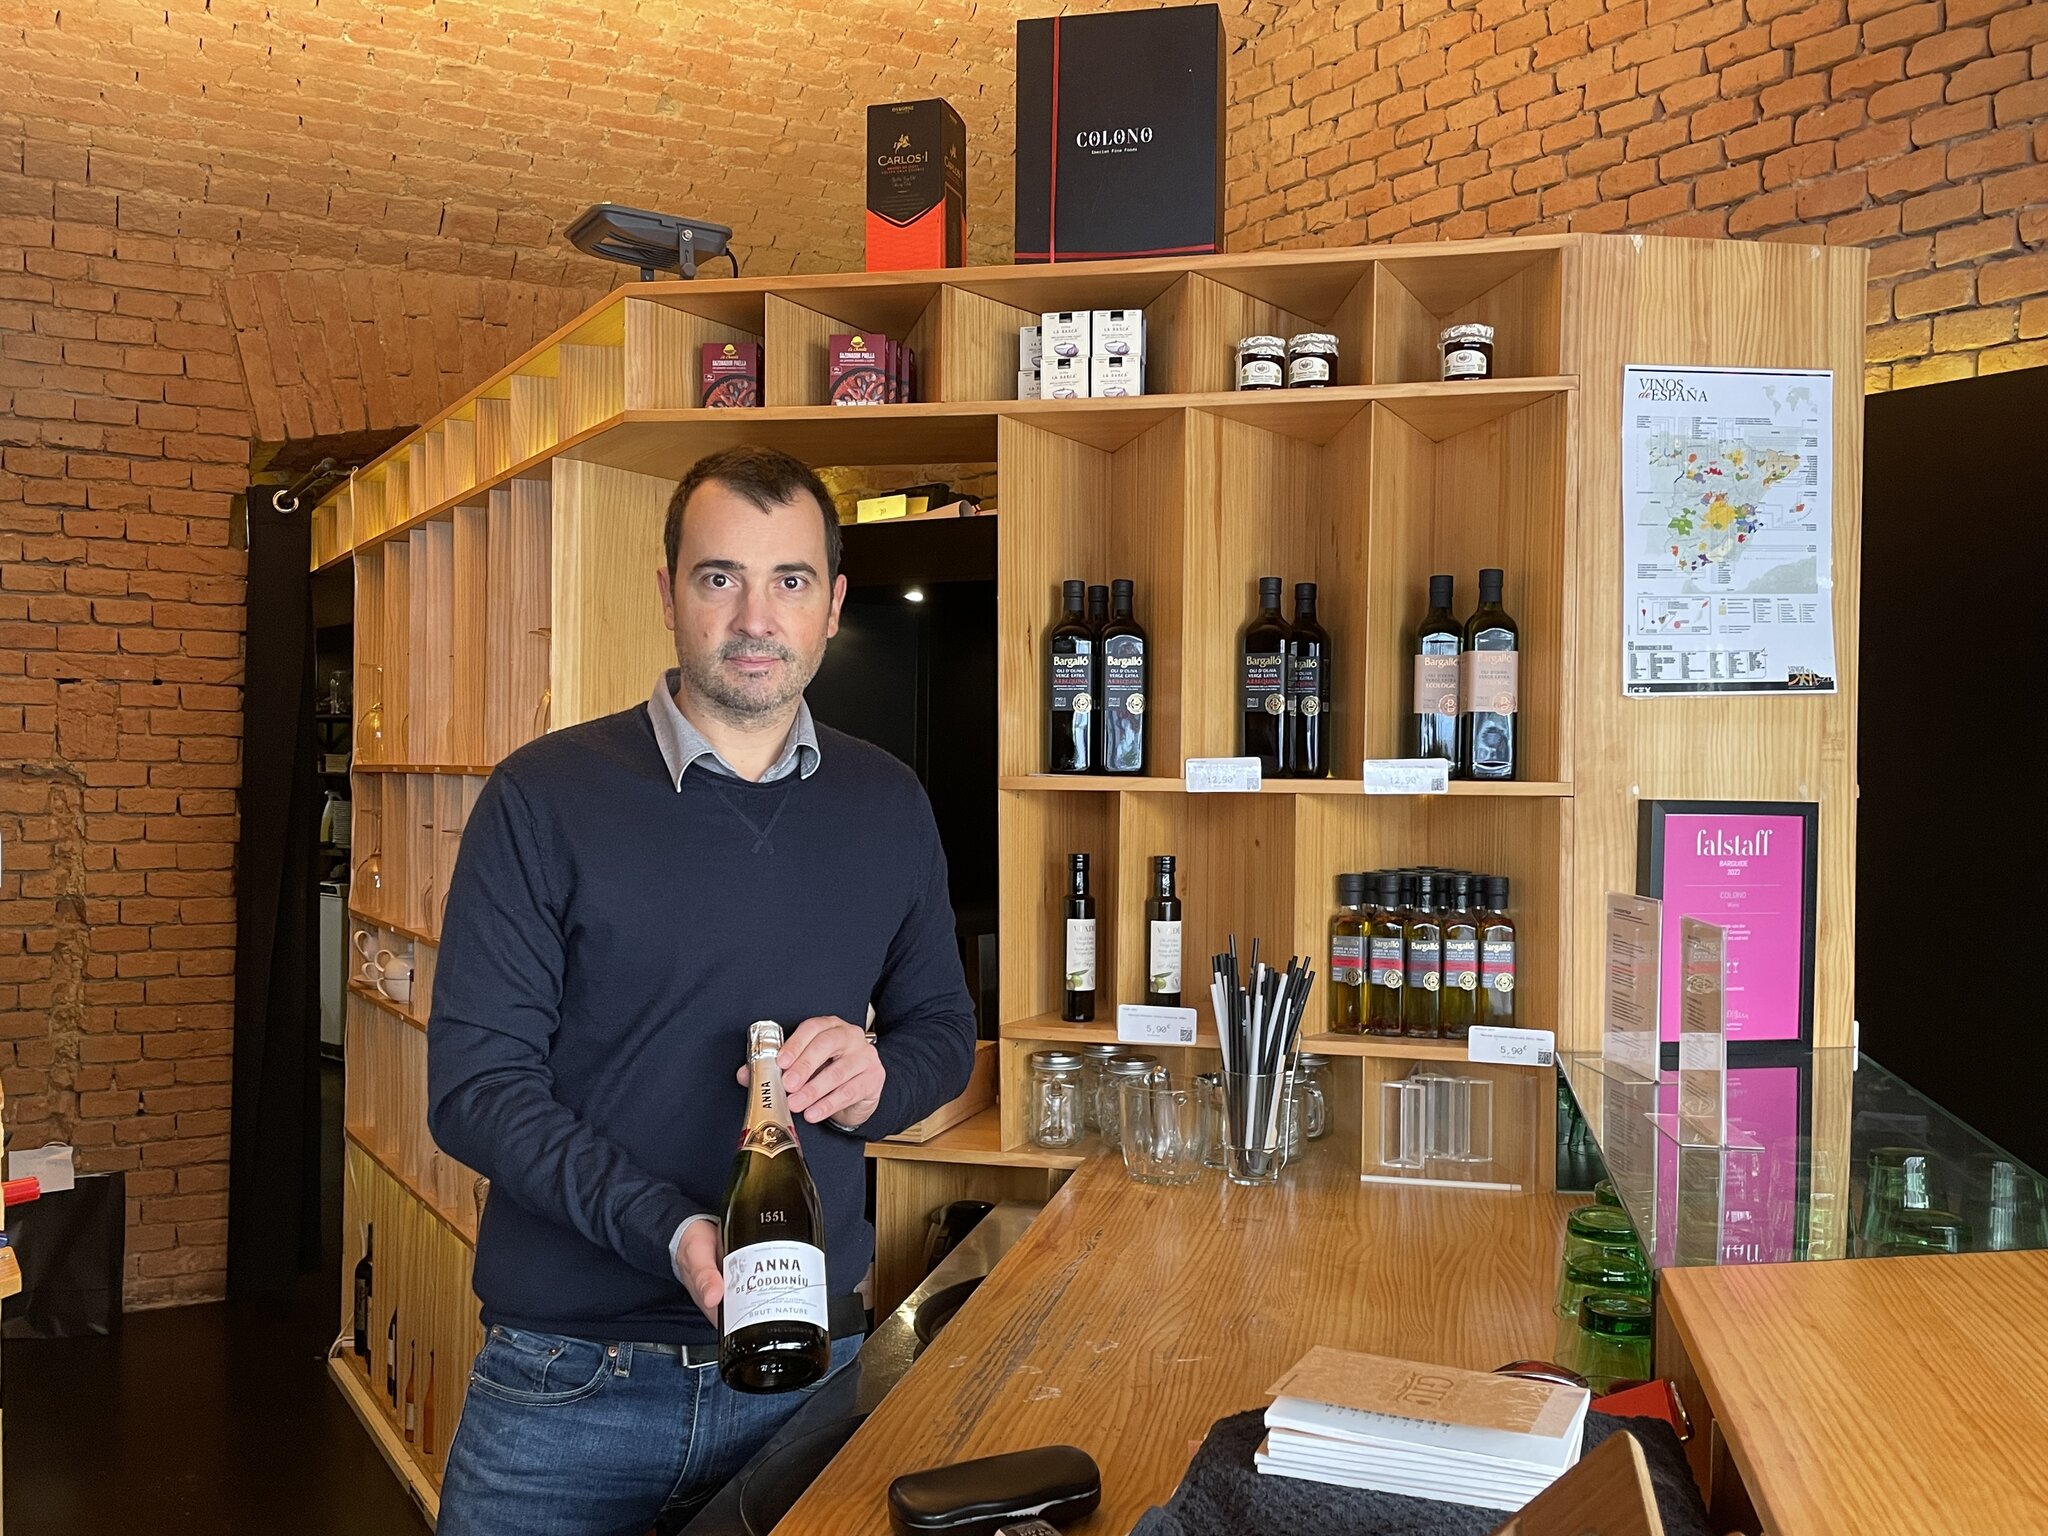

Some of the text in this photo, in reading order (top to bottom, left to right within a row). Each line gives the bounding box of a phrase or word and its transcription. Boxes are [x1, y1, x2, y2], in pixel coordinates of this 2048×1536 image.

[1076, 127, 1152, 148] COLONO
[1640, 378, 1684, 390] VINOS
[1638, 387, 1708, 402] de ESPAÑA
[1054, 656, 1088, 668] Bargalló
[1107, 656, 1142, 668] Bargalló
[1246, 656, 1281, 667] Bargalló
[1697, 829, 1773, 856] falstaff
[1411, 942, 1439, 952] Bargalló
[1447, 942, 1475, 952] Bargalló
[1500, 1045, 1527, 1055] 5,90€
[761, 1081, 772, 1109] ANNA
[754, 1259, 801, 1274] ANNA
[736, 1285, 744, 1294] DE
[749, 1308, 770, 1318] BRUT
